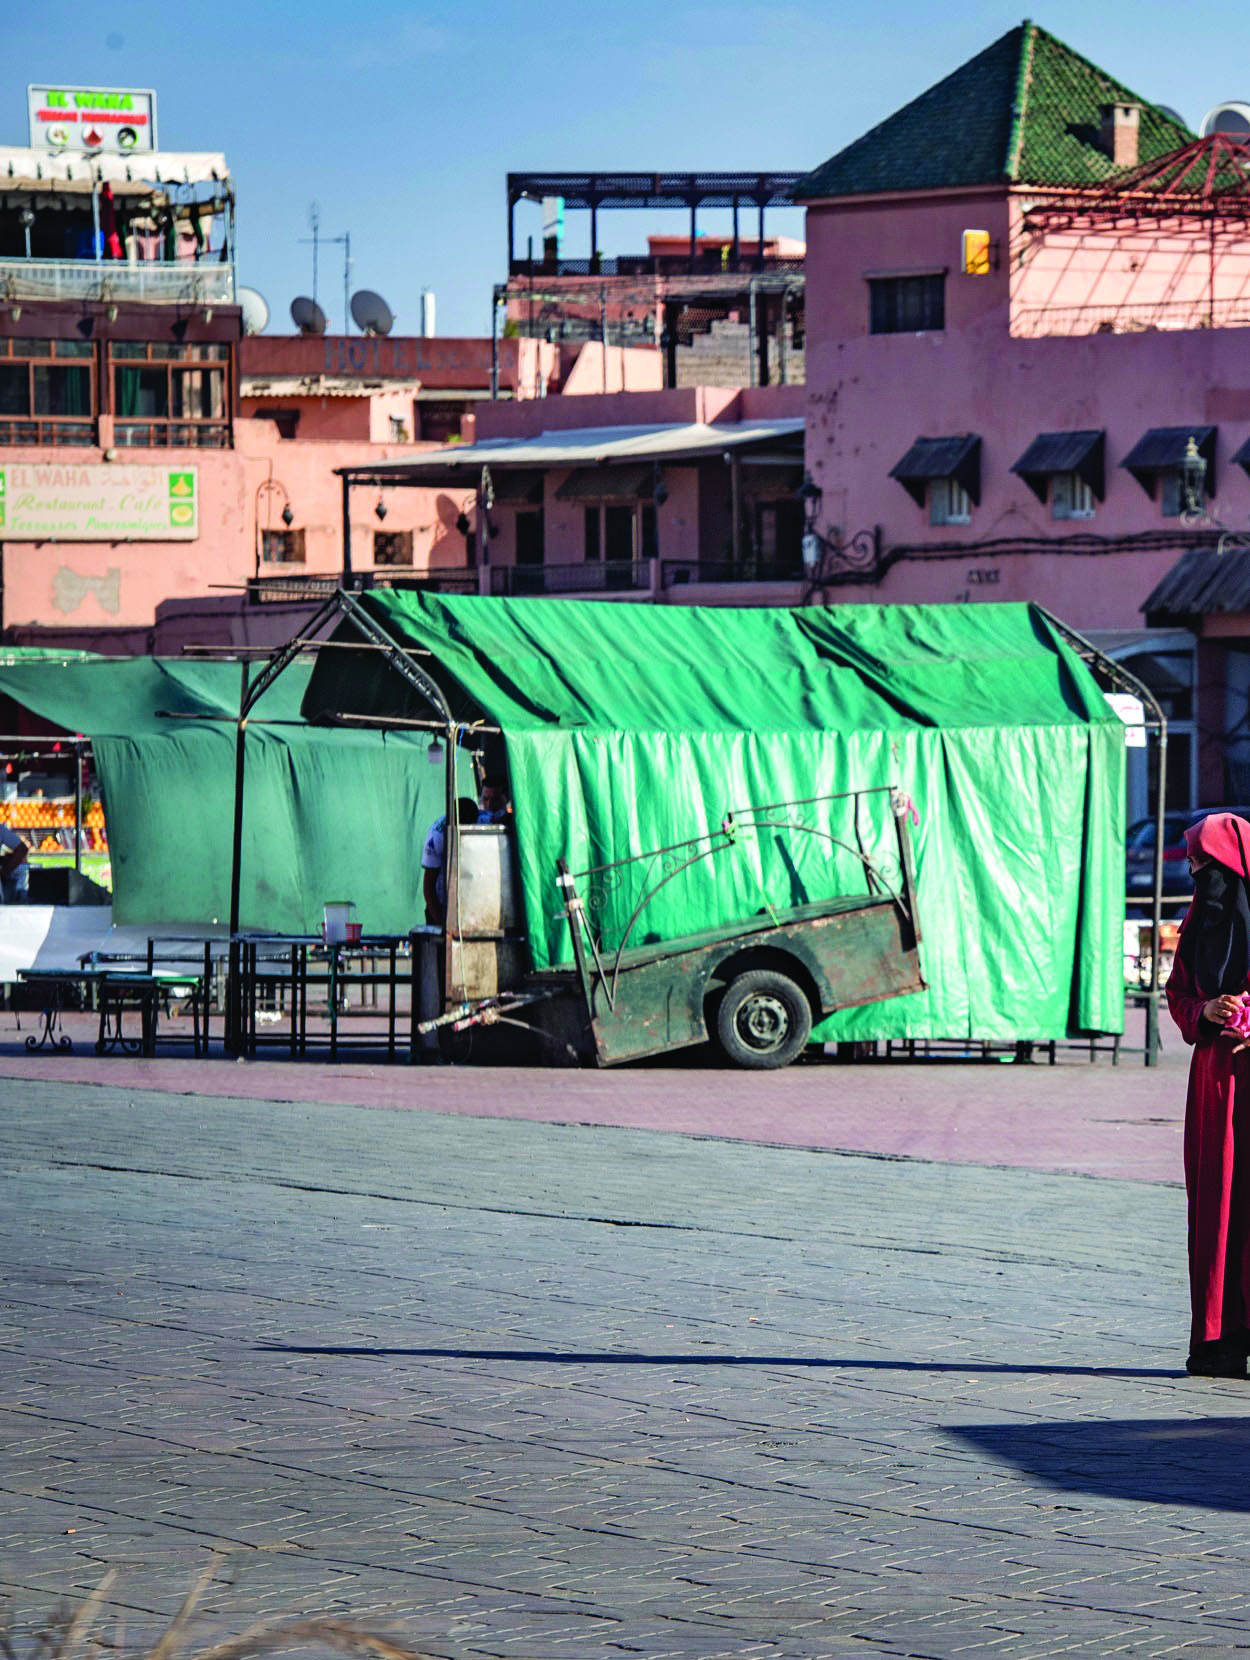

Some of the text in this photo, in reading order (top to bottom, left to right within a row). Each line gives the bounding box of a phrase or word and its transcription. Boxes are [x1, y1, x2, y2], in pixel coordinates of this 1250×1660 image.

[47, 90, 134, 109] EL WAHA
[324, 338, 432, 369] HOTEL
[10, 467, 90, 489] EL WAHA
[12, 495, 106, 512] Restaurant
